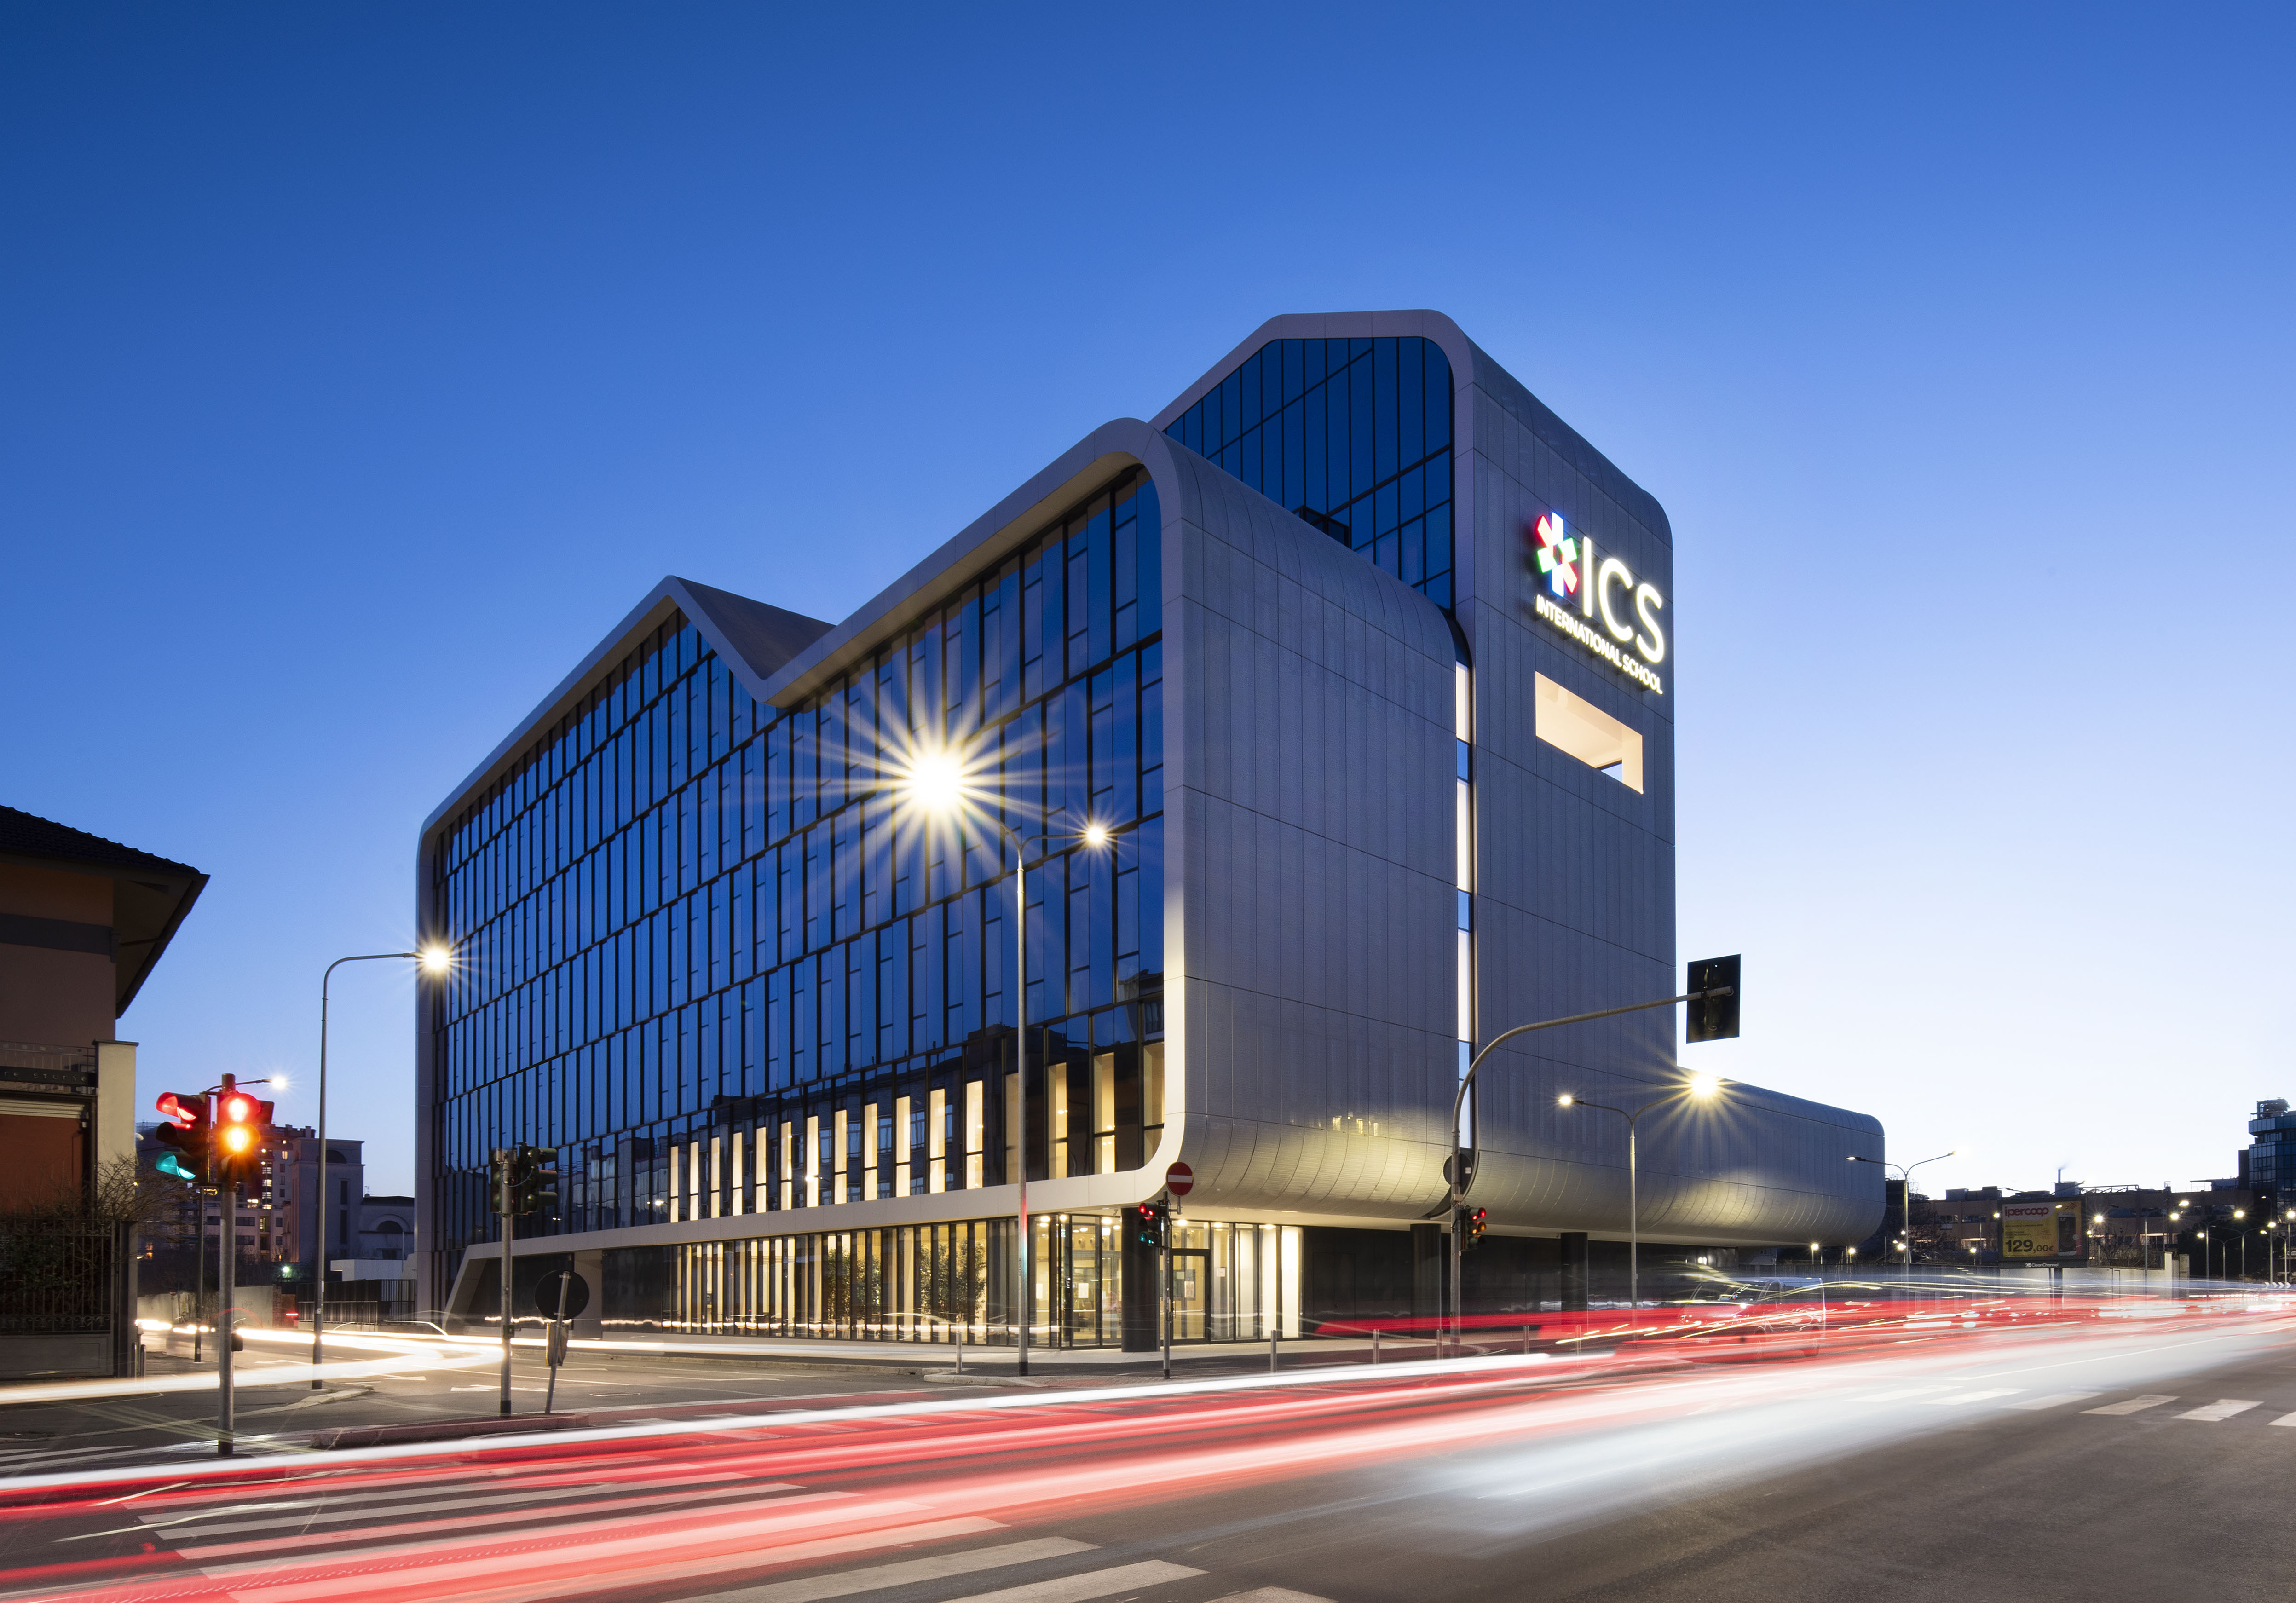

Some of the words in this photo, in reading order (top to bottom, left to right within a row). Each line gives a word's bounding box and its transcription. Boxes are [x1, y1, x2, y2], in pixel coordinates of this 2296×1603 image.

[1582, 536, 1664, 663] ICS
[1536, 594, 1622, 667] INTERNATIONAL
[1622, 654, 1663, 695] SCHOOL
[33, 1073, 87, 1082] storie
[2005, 1206, 2049, 1217] ipercoop
[2005, 1239, 2054, 1254] 129,00€
